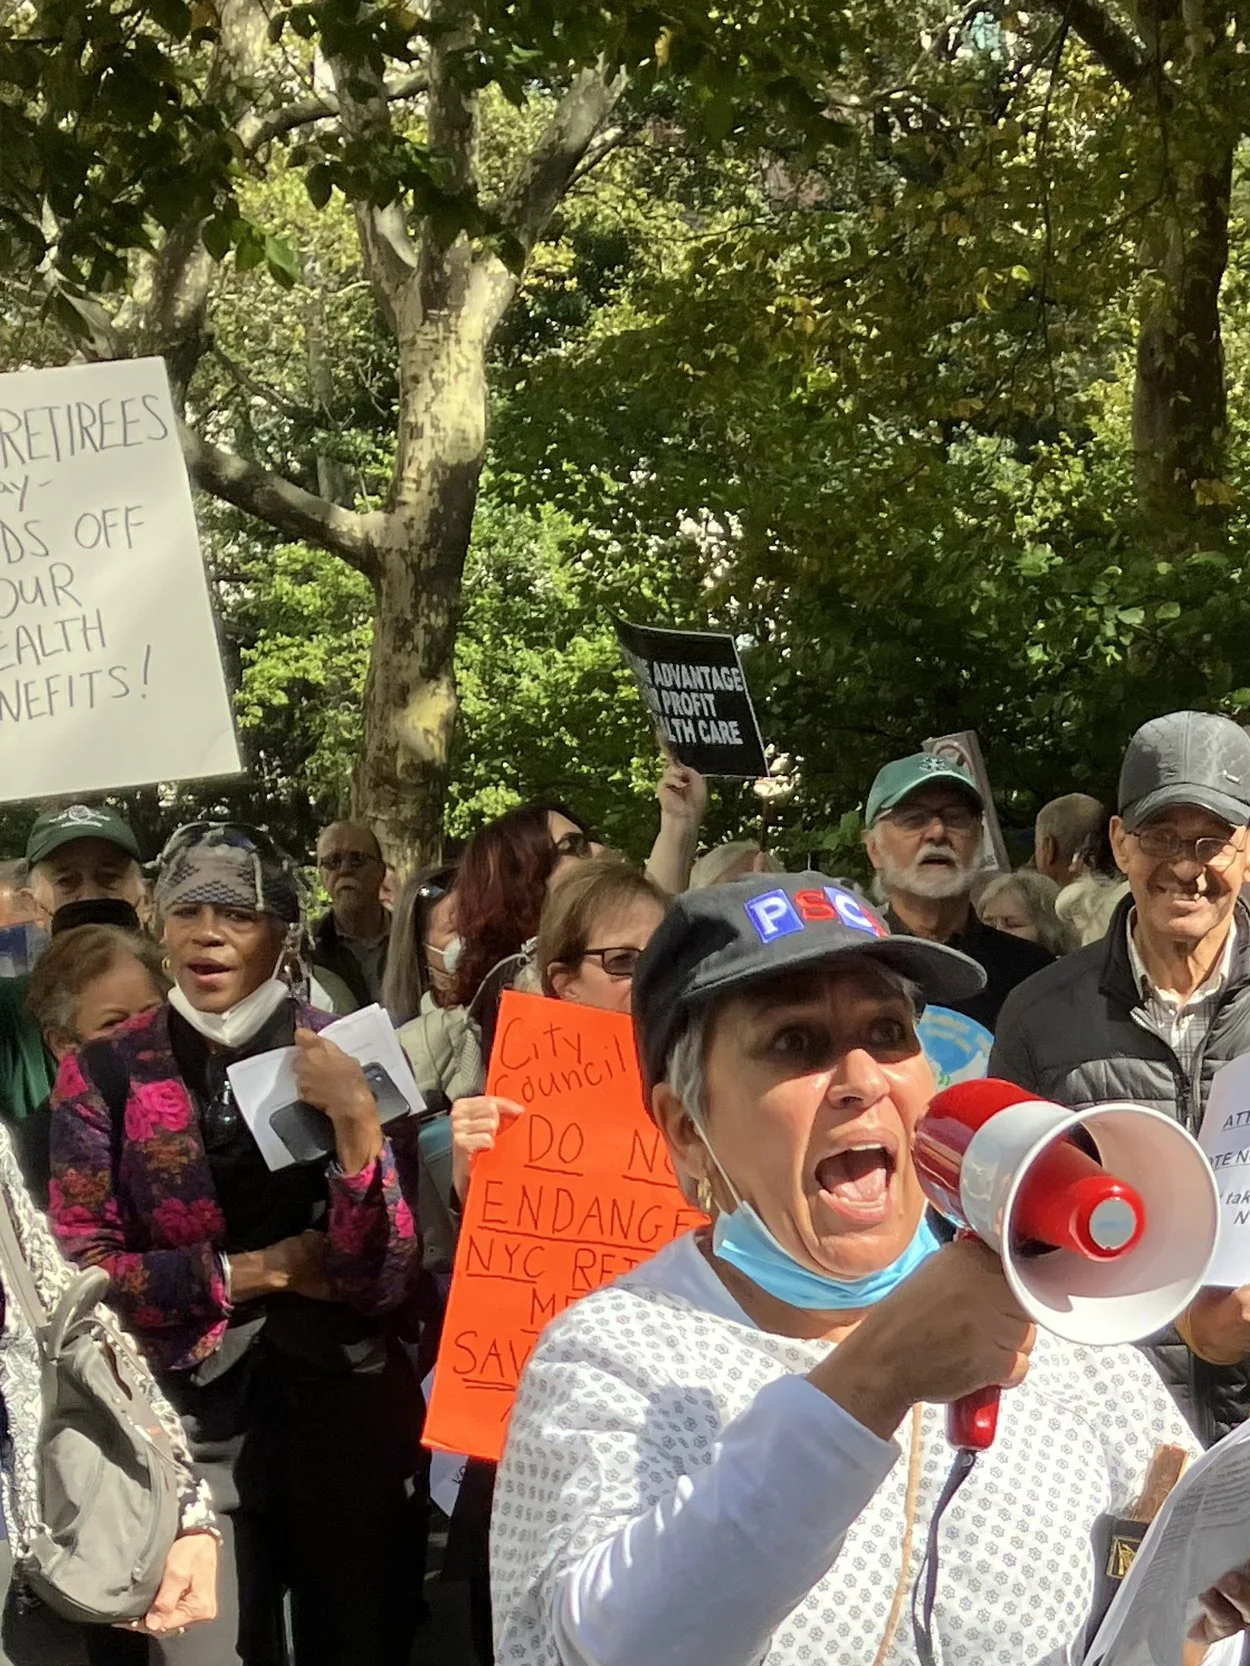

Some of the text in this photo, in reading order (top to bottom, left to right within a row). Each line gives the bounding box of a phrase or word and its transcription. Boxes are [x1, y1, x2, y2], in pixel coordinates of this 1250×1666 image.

[0, 394, 168, 468] RETIREES
[74, 505, 144, 550] OFF
[653, 661, 744, 692] ADVANTAGE
[661, 690, 717, 717] PROFIT
[698, 720, 744, 744] CARE
[529, 1114, 584, 1164] DO
[482, 1180, 696, 1243] ENDANGE
[466, 1235, 545, 1278] NYC
[453, 1330, 532, 1378] SAV
